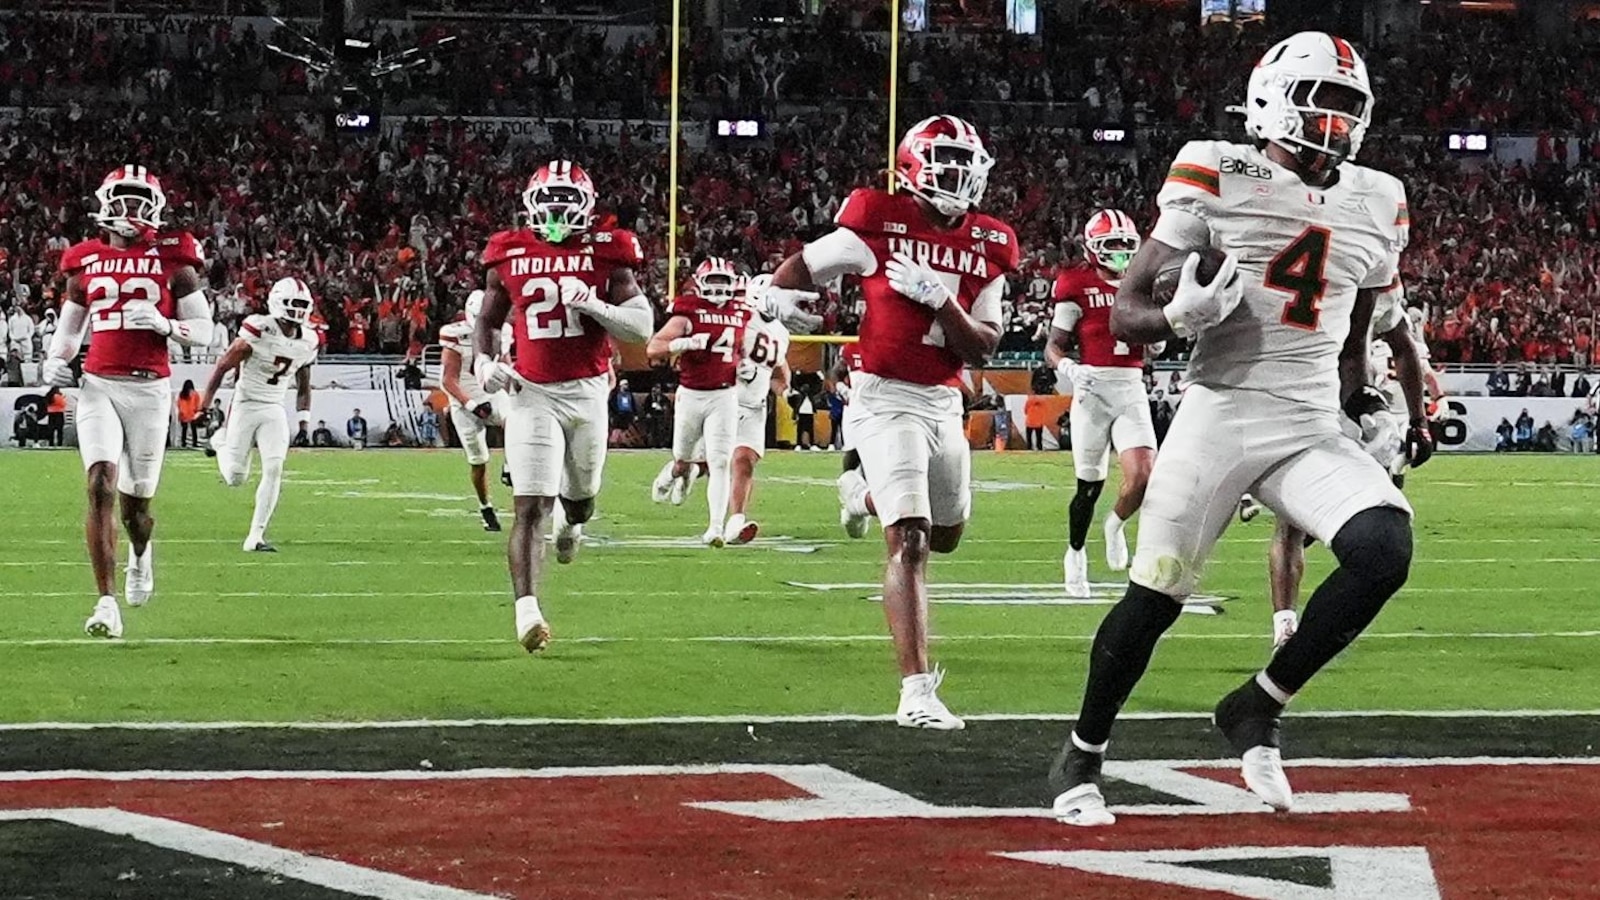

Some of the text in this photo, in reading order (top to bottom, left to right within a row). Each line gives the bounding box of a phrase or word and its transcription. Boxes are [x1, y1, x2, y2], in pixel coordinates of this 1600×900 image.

[84, 258, 163, 275] INDIANA
[510, 256, 595, 277] INDIANA
[888, 238, 988, 278] INDIANA
[1263, 225, 1332, 331] 4
[750, 331, 779, 368] 61
[267, 356, 292, 386] 7
